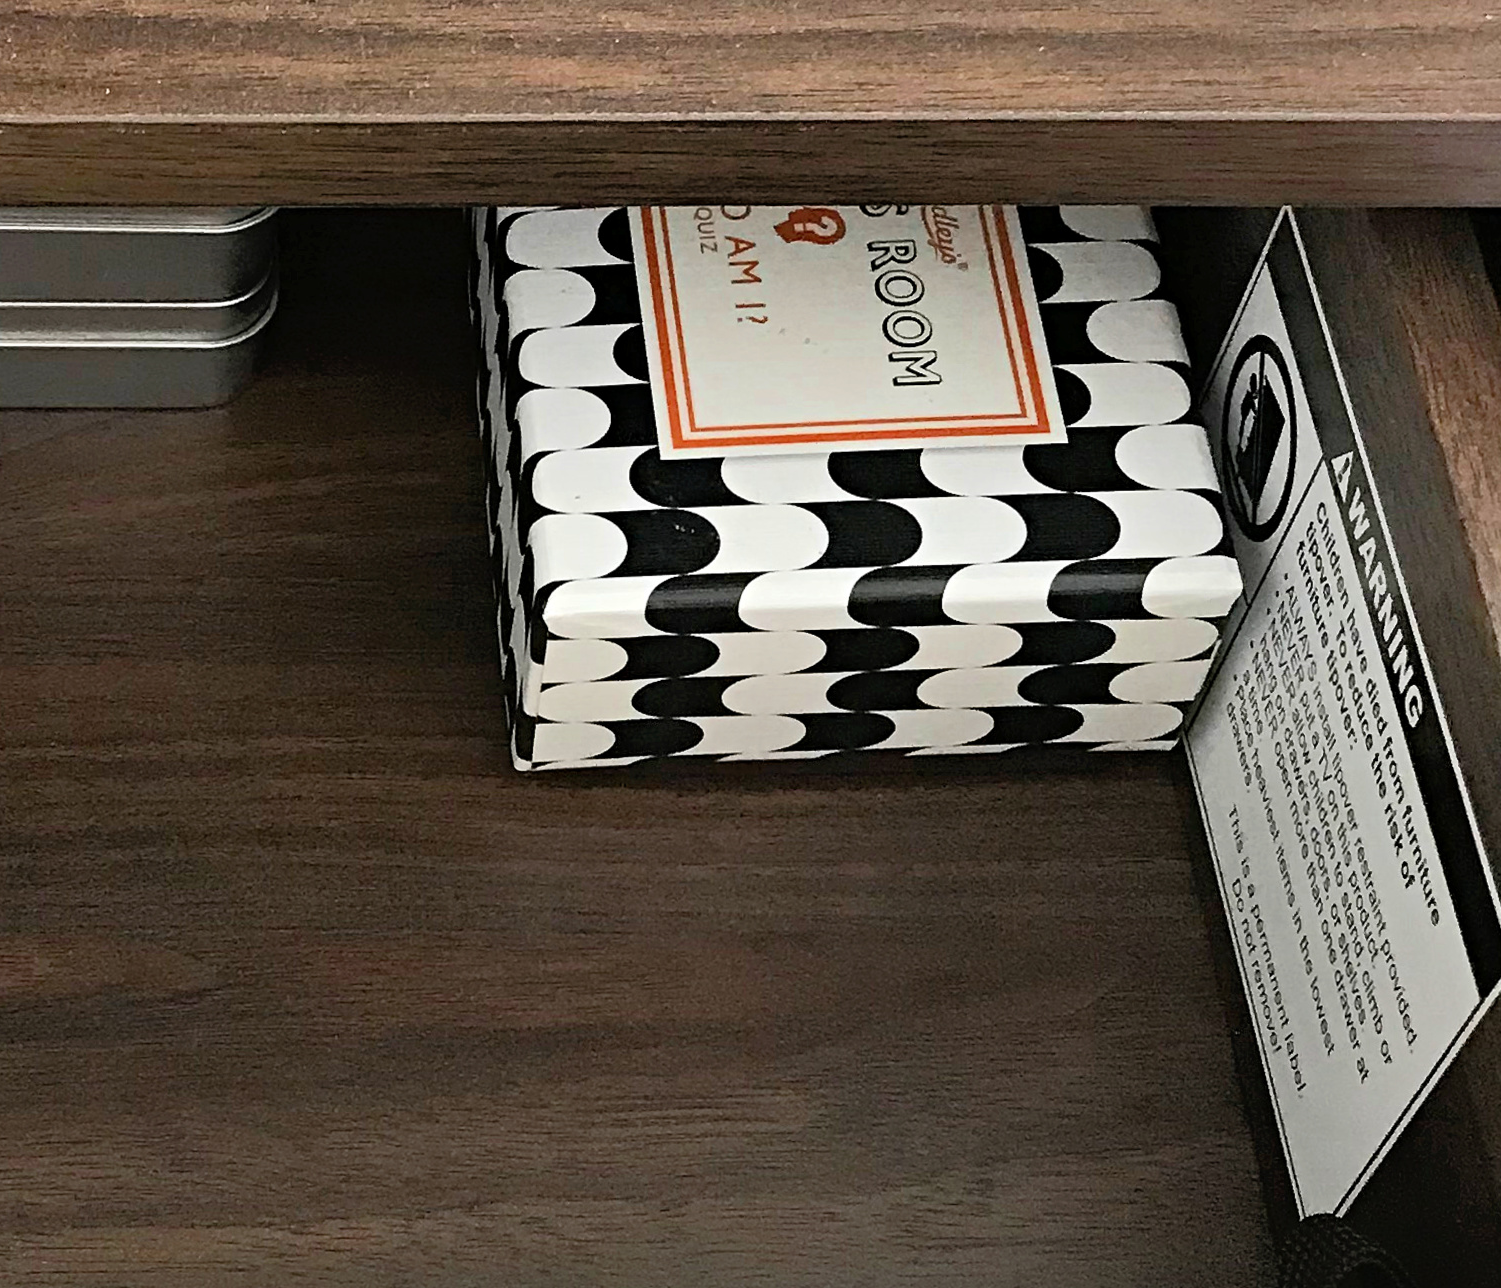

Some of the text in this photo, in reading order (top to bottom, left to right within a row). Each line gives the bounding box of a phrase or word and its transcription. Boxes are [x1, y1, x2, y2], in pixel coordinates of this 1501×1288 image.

[694, 206, 717, 253] QUIZ
[725, 236, 763, 285] AM
[734, 303, 768, 325] I?
[867, 238, 942, 387] ROOM
[1296, 540, 1328, 648] furniture
[1348, 486, 1422, 727] WARNING
[1242, 669, 1250, 686] a
[1276, 600, 1304, 688] NEVER
[1298, 690, 1315, 730] put
[1311, 731, 1319, 749] a
[1318, 746, 1332, 781] TV
[1327, 789, 1339, 821] on
[1336, 821, 1352, 867] this
[1316, 501, 1439, 926] Children have died from furniture
[1259, 632, 1277, 693] hang
[1271, 694, 1285, 724] on
[1330, 902, 1341, 927] or
[1285, 585, 1316, 681] ALWAYS
[1312, 681, 1336, 751] install
[1331, 751, 1358, 831] tipover
[1353, 837, 1386, 937] restraint
[1335, 620, 1346, 658] To
[1344, 660, 1373, 751] reduce
[1370, 752, 1386, 799] the
[1384, 803, 1403, 857] risk
[1400, 860, 1415, 888] of
[1228, 803, 1243, 853] This
[1234, 684, 1334, 1056] Place heaviest items in the lowest
[1240, 856, 1250, 878] is
[1247, 883, 1254, 898] a
[1251, 651, 1369, 1084] NEVER open more than one drawer at
[1267, 617, 1295, 706] NEVER
[1291, 707, 1311, 765] allow
[1307, 769, 1335, 859] children
[1333, 861, 1343, 887] to
[1361, 970, 1383, 1034] climb
[1380, 1039, 1392, 1063] or
[1231, 877, 1244, 912] Do
[1241, 917, 1256, 955] not
[1249, 904, 1289, 1029] permanent
